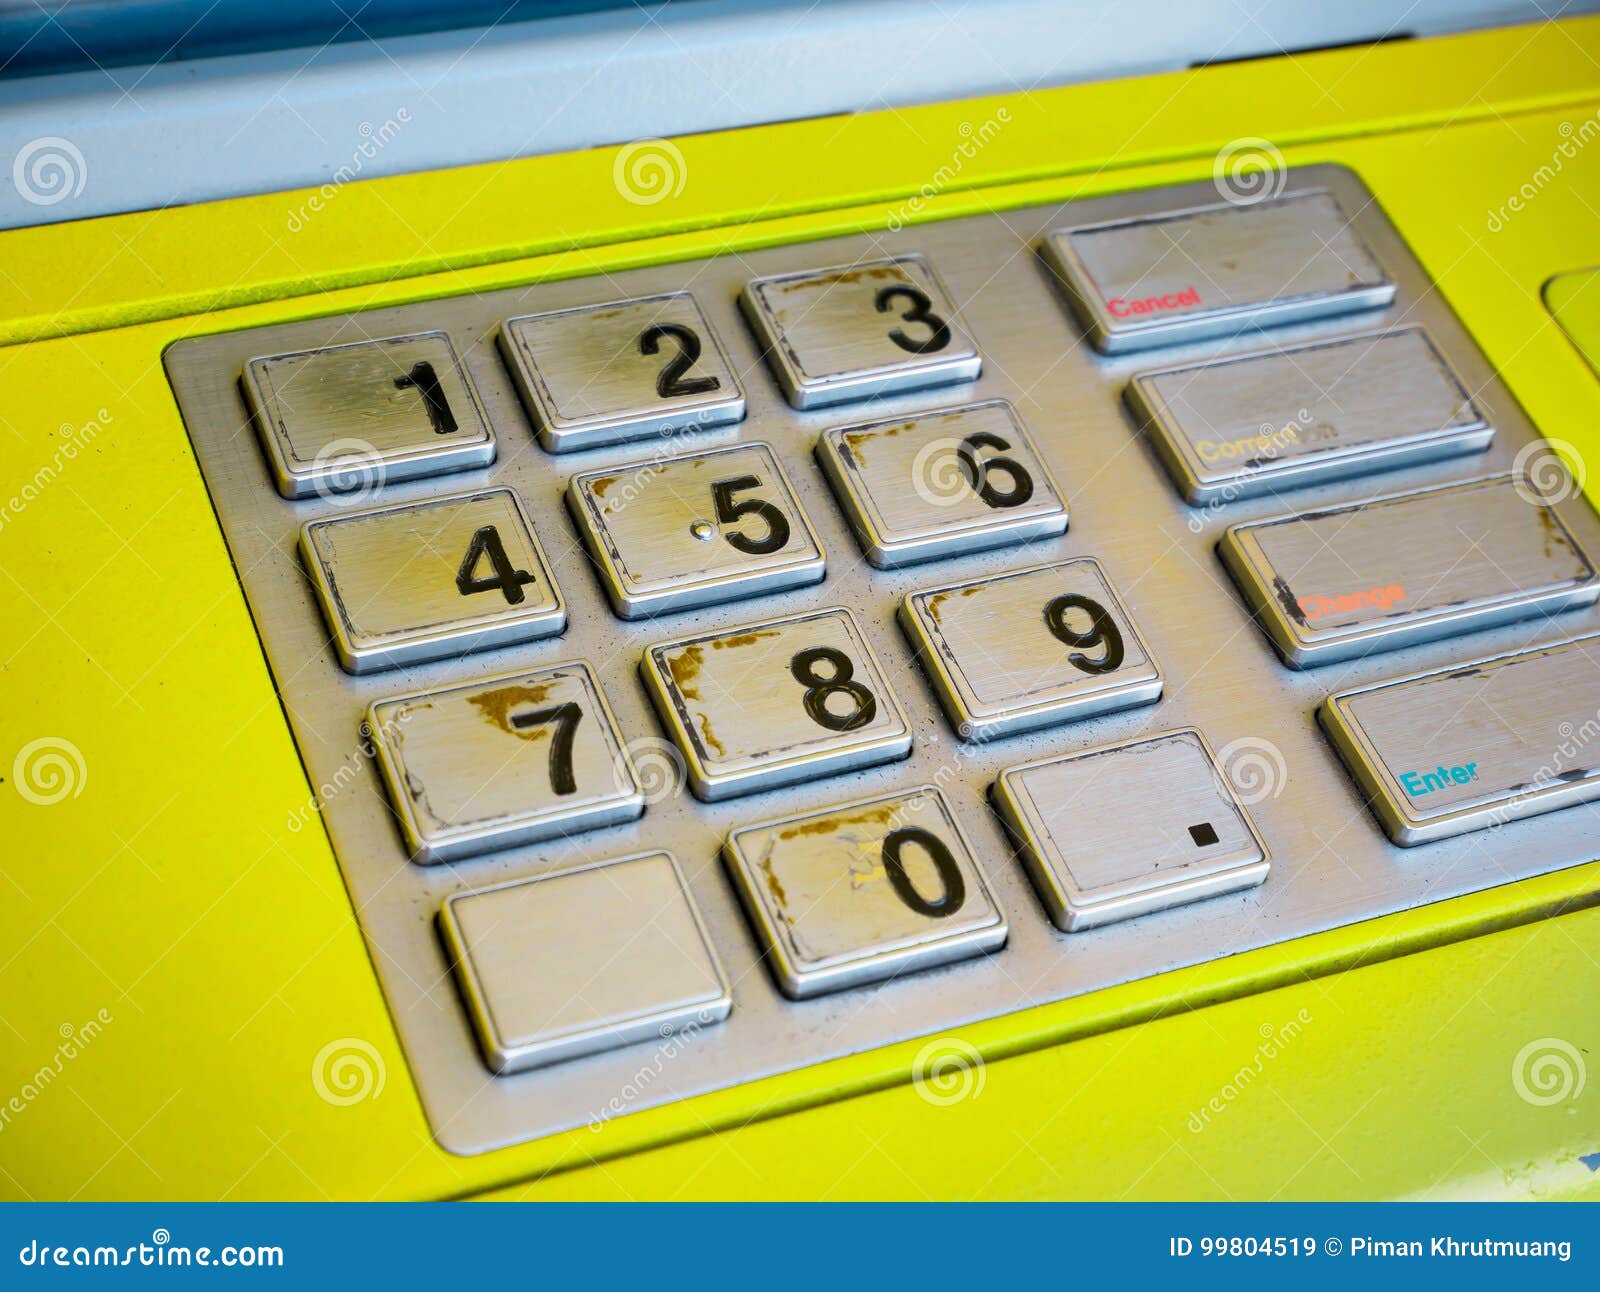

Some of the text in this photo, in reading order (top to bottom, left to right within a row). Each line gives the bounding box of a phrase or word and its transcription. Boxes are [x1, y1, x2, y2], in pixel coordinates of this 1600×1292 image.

[874, 284, 952, 355] 3
[1107, 287, 1201, 318] Cancel
[392, 360, 459, 435] 1
[637, 323, 721, 399] 2
[956, 431, 1034, 509] 6
[710, 476, 791, 555] 5
[455, 525, 537, 606] 4
[1298, 583, 1406, 619] Change
[1042, 594, 1125, 675] 9
[790, 647, 877, 732] 8
[511, 702, 584, 796] 7
[1399, 762, 1478, 797] Enter
[881, 828, 966, 919] 0
